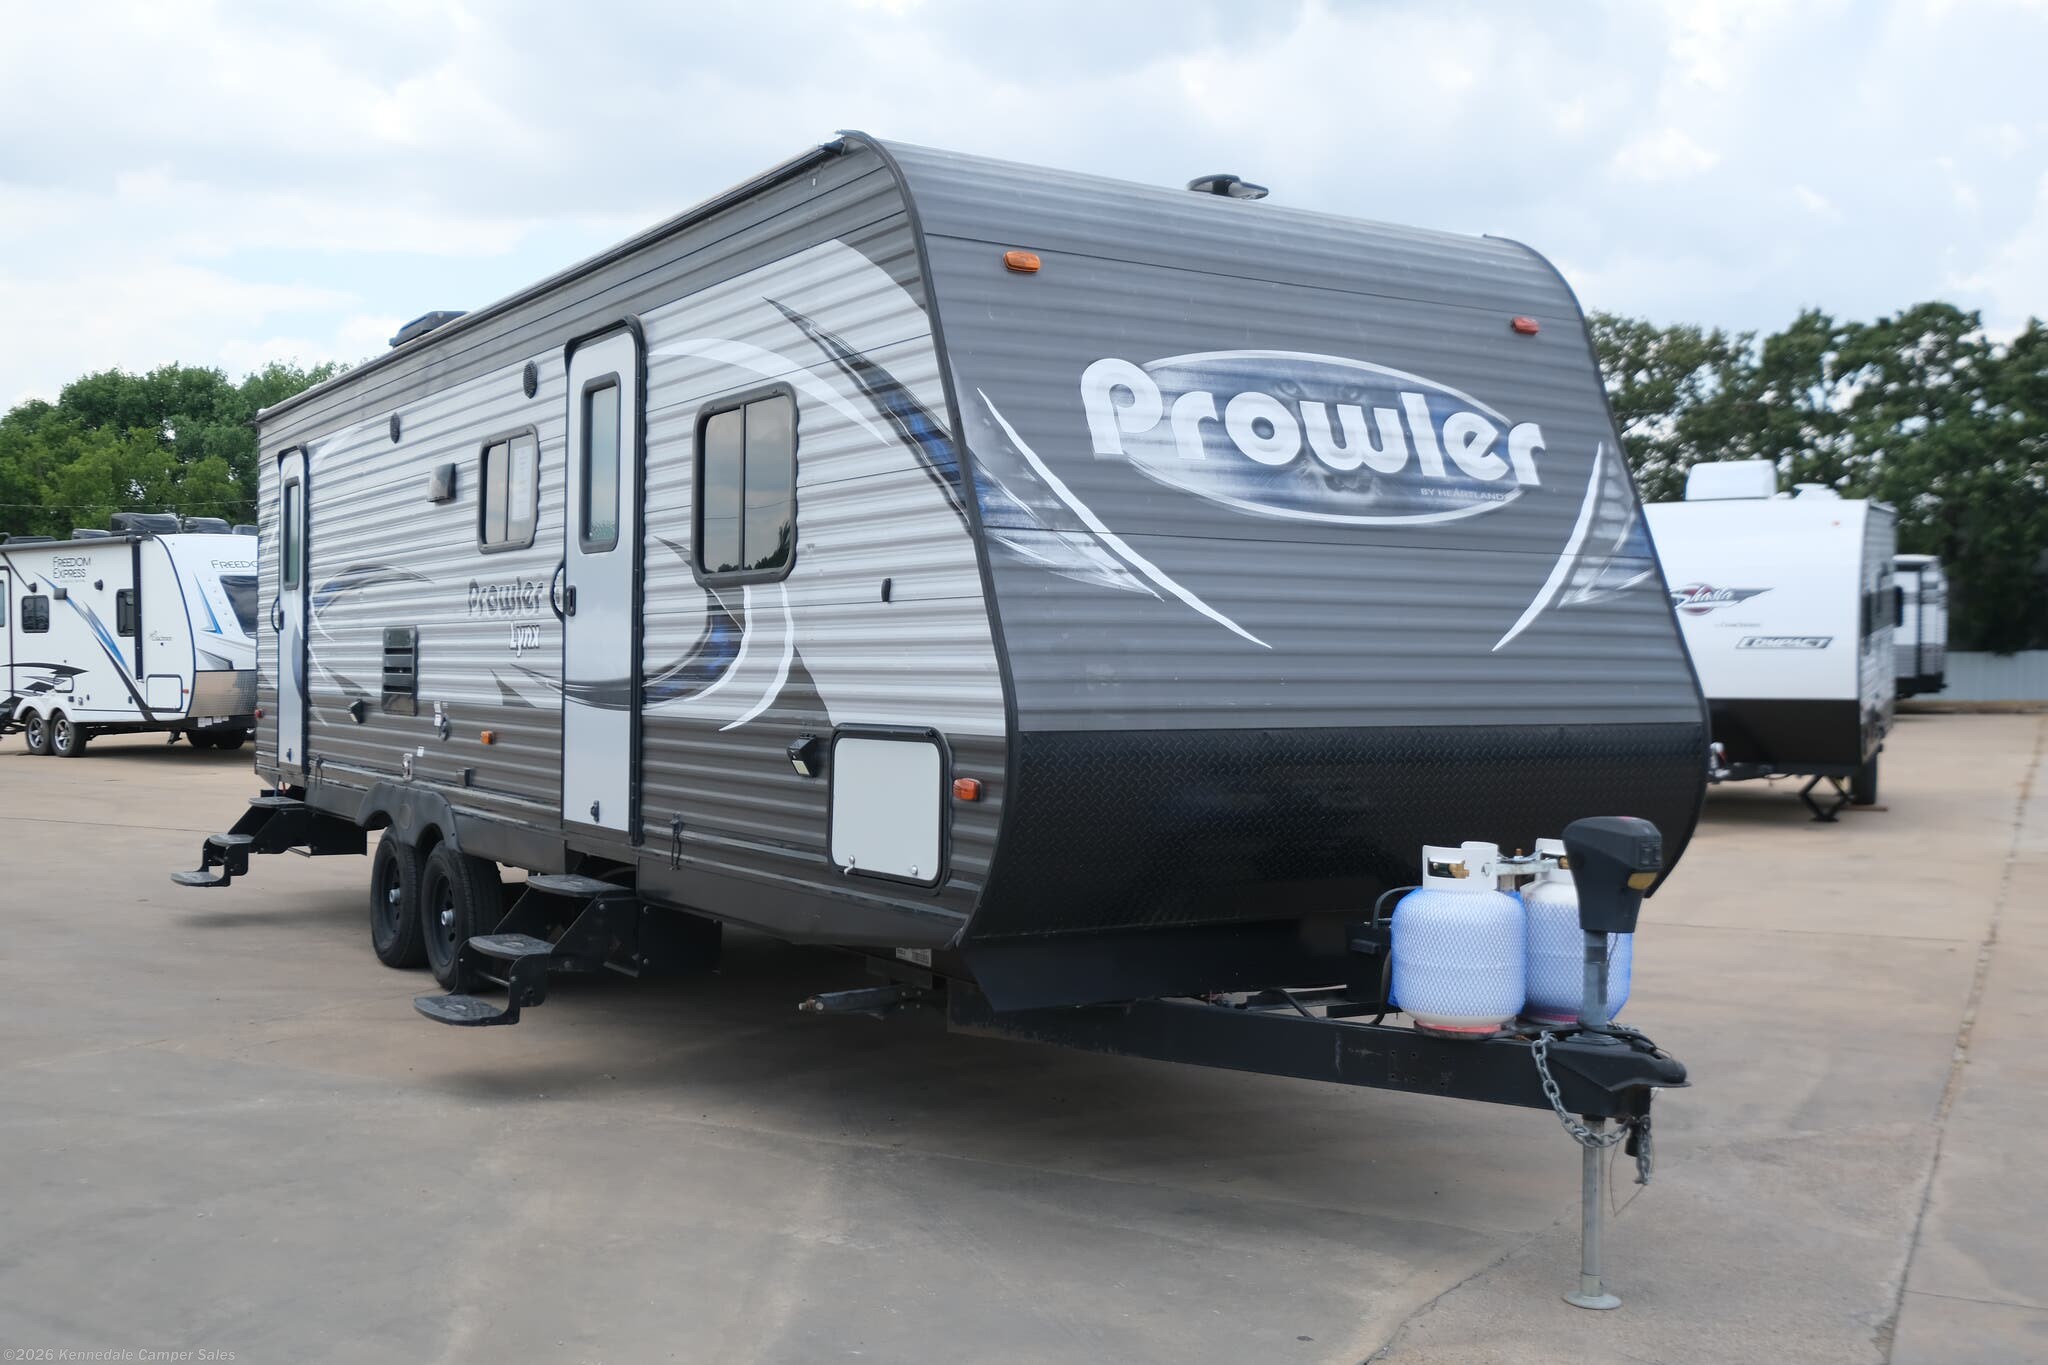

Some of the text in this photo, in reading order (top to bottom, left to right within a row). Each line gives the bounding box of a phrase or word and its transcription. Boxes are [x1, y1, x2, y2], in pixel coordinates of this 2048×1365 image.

[1081, 358, 1546, 486] Prowler
[1420, 488, 1504, 501] BY HEARTLAND
[53, 556, 91, 567] FREEDOM
[211, 559, 258, 569] FREEDO
[53, 567, 86, 579] EXPRESS
[468, 576, 544, 617] Prowler
[509, 622, 540, 658] Lynx
